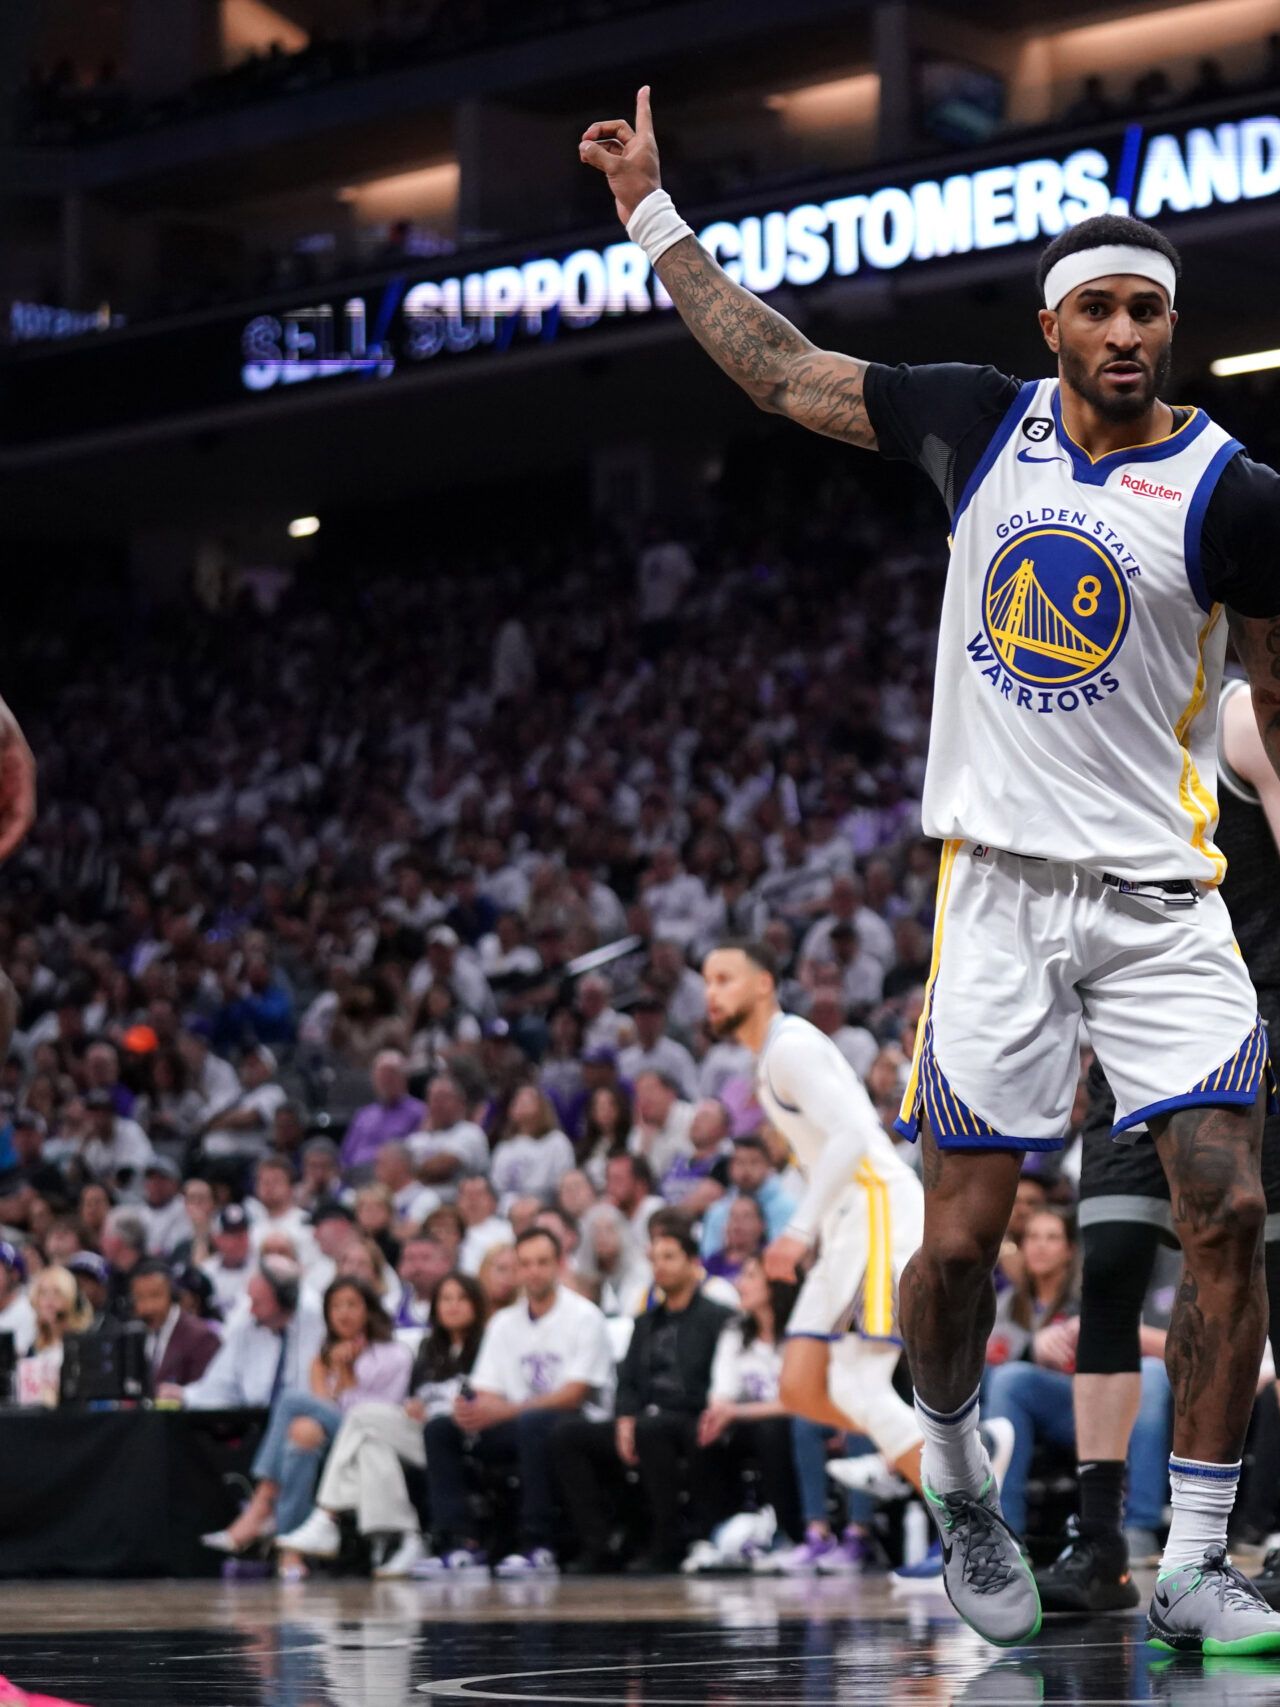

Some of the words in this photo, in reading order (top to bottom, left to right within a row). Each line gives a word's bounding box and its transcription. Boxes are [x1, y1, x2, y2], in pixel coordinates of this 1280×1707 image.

[1027, 421, 1050, 440] 6
[1121, 474, 1182, 501] Rakuten
[996, 507, 1087, 539] GOLDEN
[1093, 521, 1142, 579] STATE
[1072, 575, 1102, 617] 8
[966, 631, 1120, 713] WARRIORS
